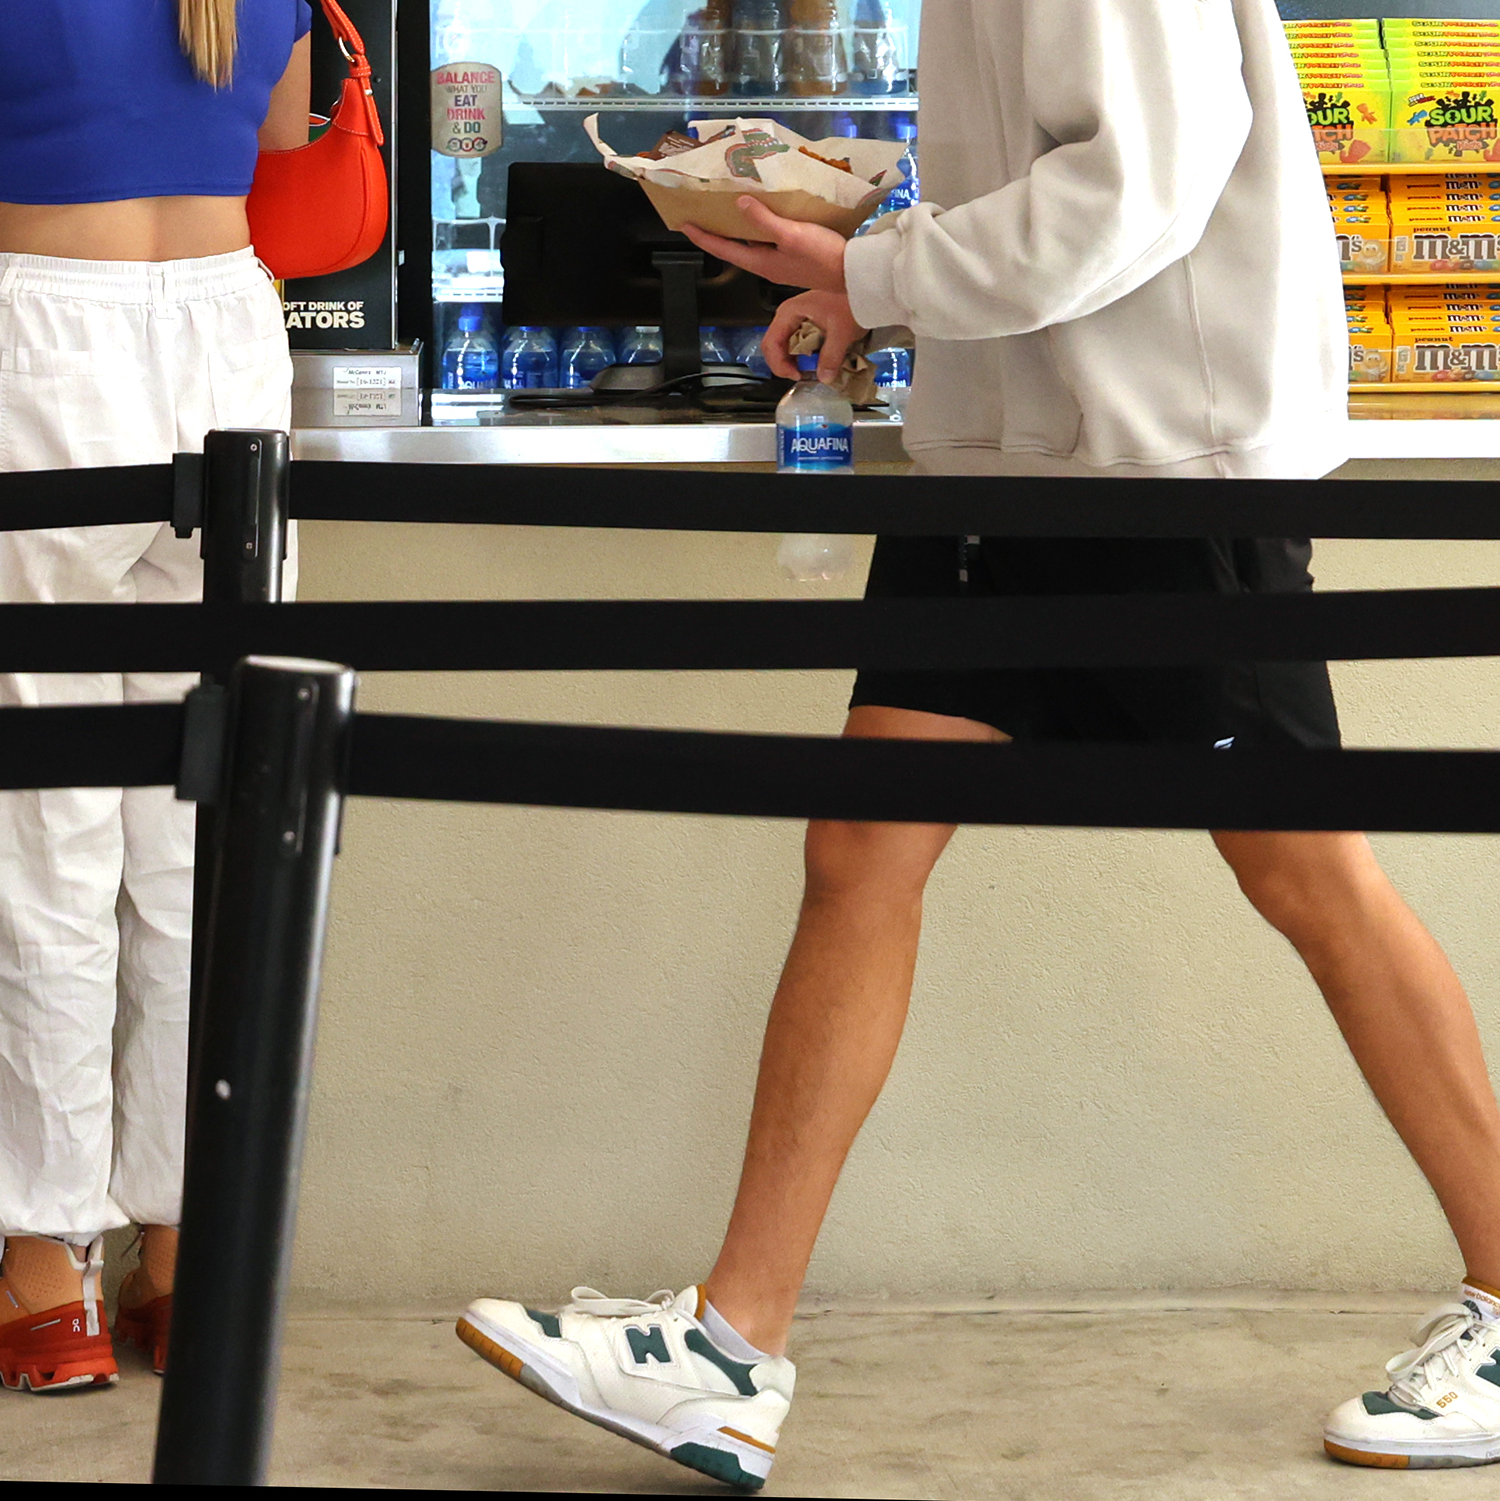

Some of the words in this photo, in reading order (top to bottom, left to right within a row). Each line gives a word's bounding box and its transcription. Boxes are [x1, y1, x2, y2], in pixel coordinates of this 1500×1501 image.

[437, 71, 495, 84] BALANCE
[446, 85, 468, 94] WHAT
[471, 85, 487, 94] YOU
[454, 95, 477, 107] EAT
[447, 108, 485, 120] DRINK
[1307, 107, 1349, 125] OUR
[1429, 106, 1493, 125] SOUR
[452, 122, 461, 134] &
[464, 122, 481, 133] DO
[1311, 124, 1354, 142] TCH
[1427, 122, 1497, 145] PATCH
[283, 301, 306, 311] OFT
[308, 301, 345, 311] DRINK
[347, 301, 364, 311] OF
[285, 311, 365, 329] ATORS
[790, 437, 850, 454] AQUAFINA
[1436, 1391, 1458, 1409] 550
